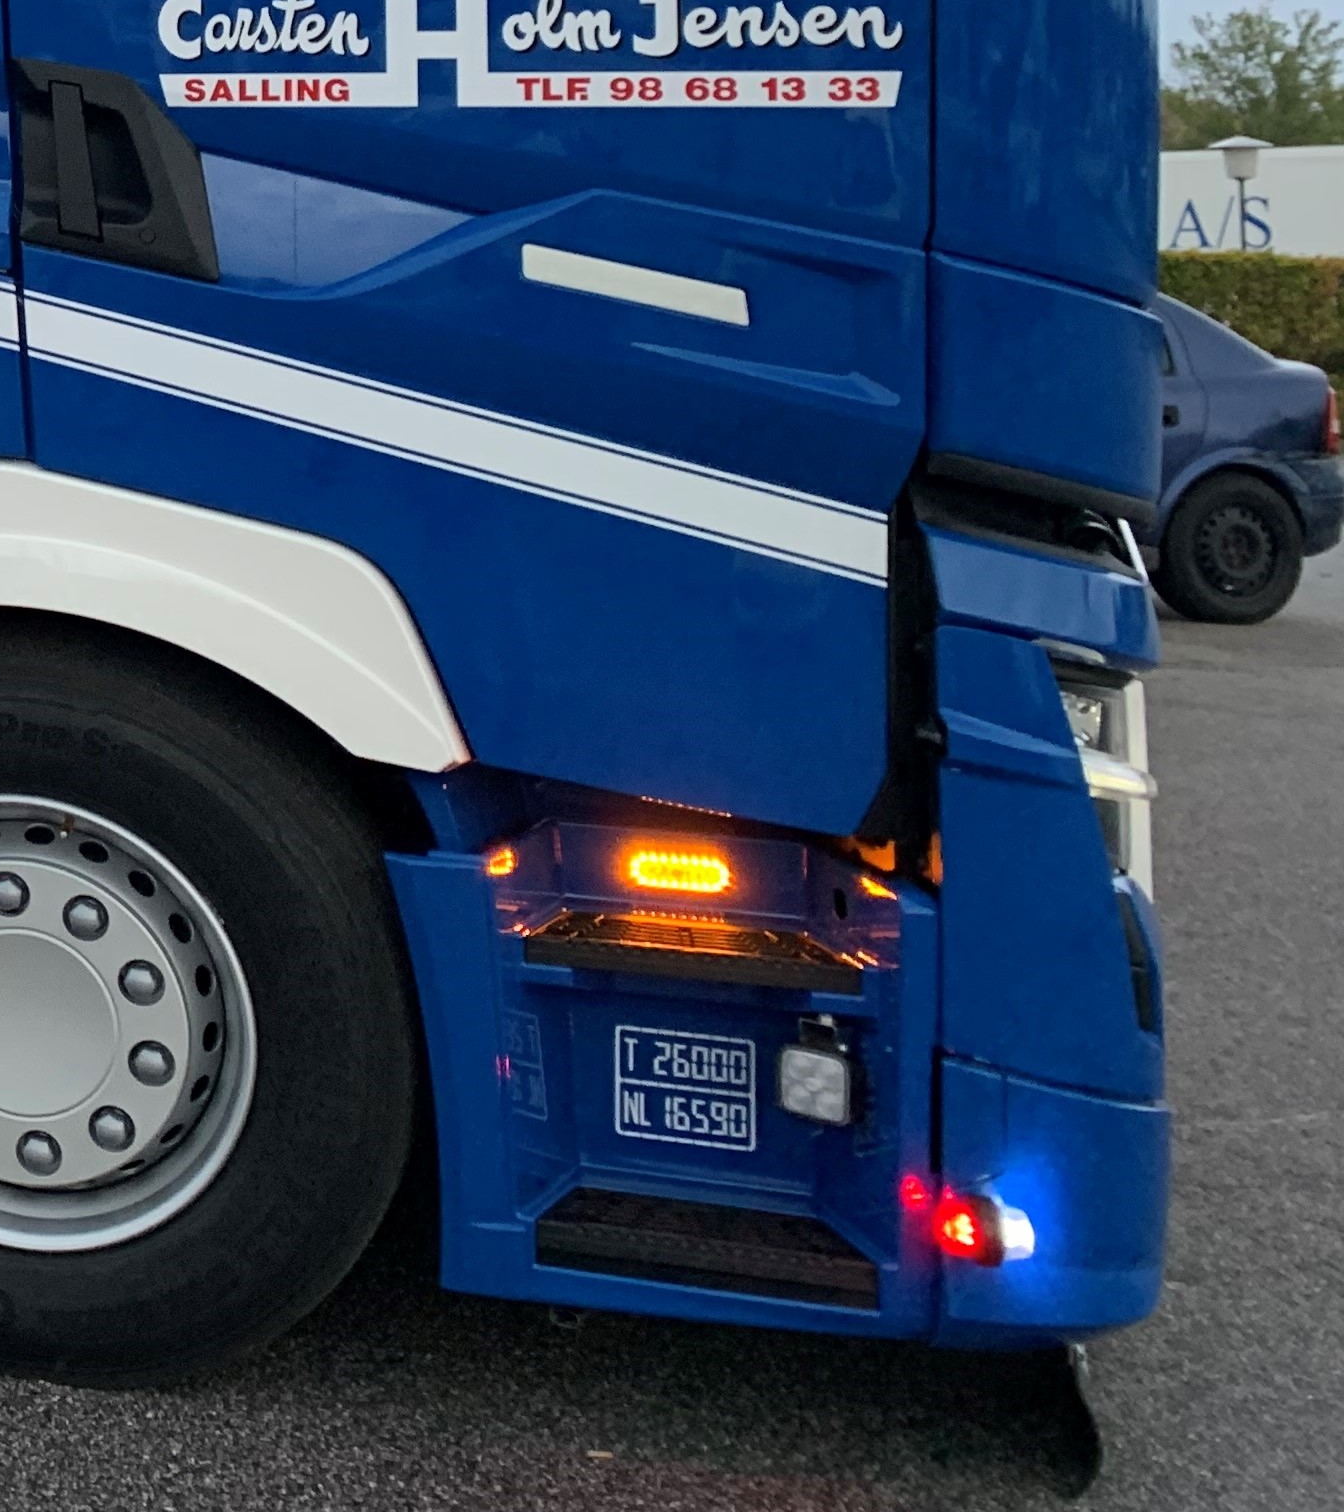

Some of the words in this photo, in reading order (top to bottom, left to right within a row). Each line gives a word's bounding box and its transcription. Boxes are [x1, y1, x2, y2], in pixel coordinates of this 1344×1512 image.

[184, 79, 350, 103] SALLING
[609, 77, 663, 101] 98
[684, 77, 738, 101] 68
[761, 77, 806, 101] 13
[827, 77, 880, 101] 33
[1171, 196, 1272, 249] A/S
[624, 1037, 637, 1072] T
[653, 1042, 747, 1085] 26000
[623, 1090, 650, 1126] NL
